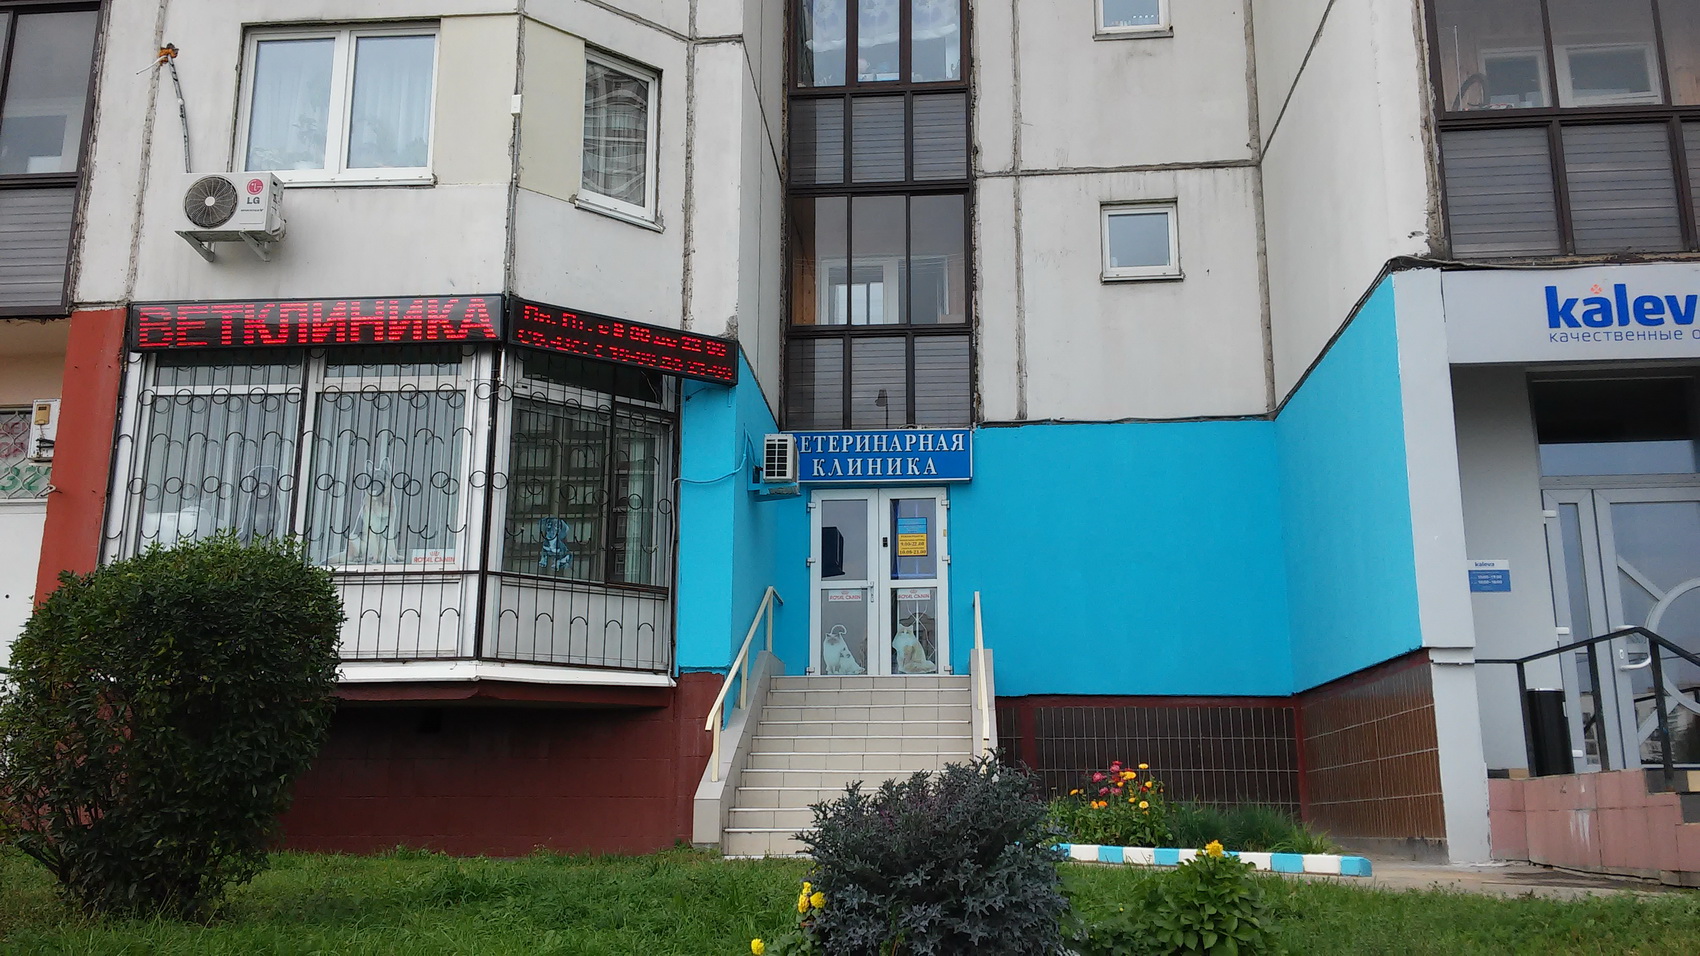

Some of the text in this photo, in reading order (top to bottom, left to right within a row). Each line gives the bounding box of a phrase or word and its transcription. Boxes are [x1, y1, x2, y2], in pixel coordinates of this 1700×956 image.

[247, 197, 260, 205] LG
[138, 298, 497, 347] ВЕТКЛИНИКА
[1549, 329, 1683, 343] качественные
[794, 433, 965, 453] ЕТЕРИНАРНАЯ
[812, 457, 938, 477] КЛИНИКА
